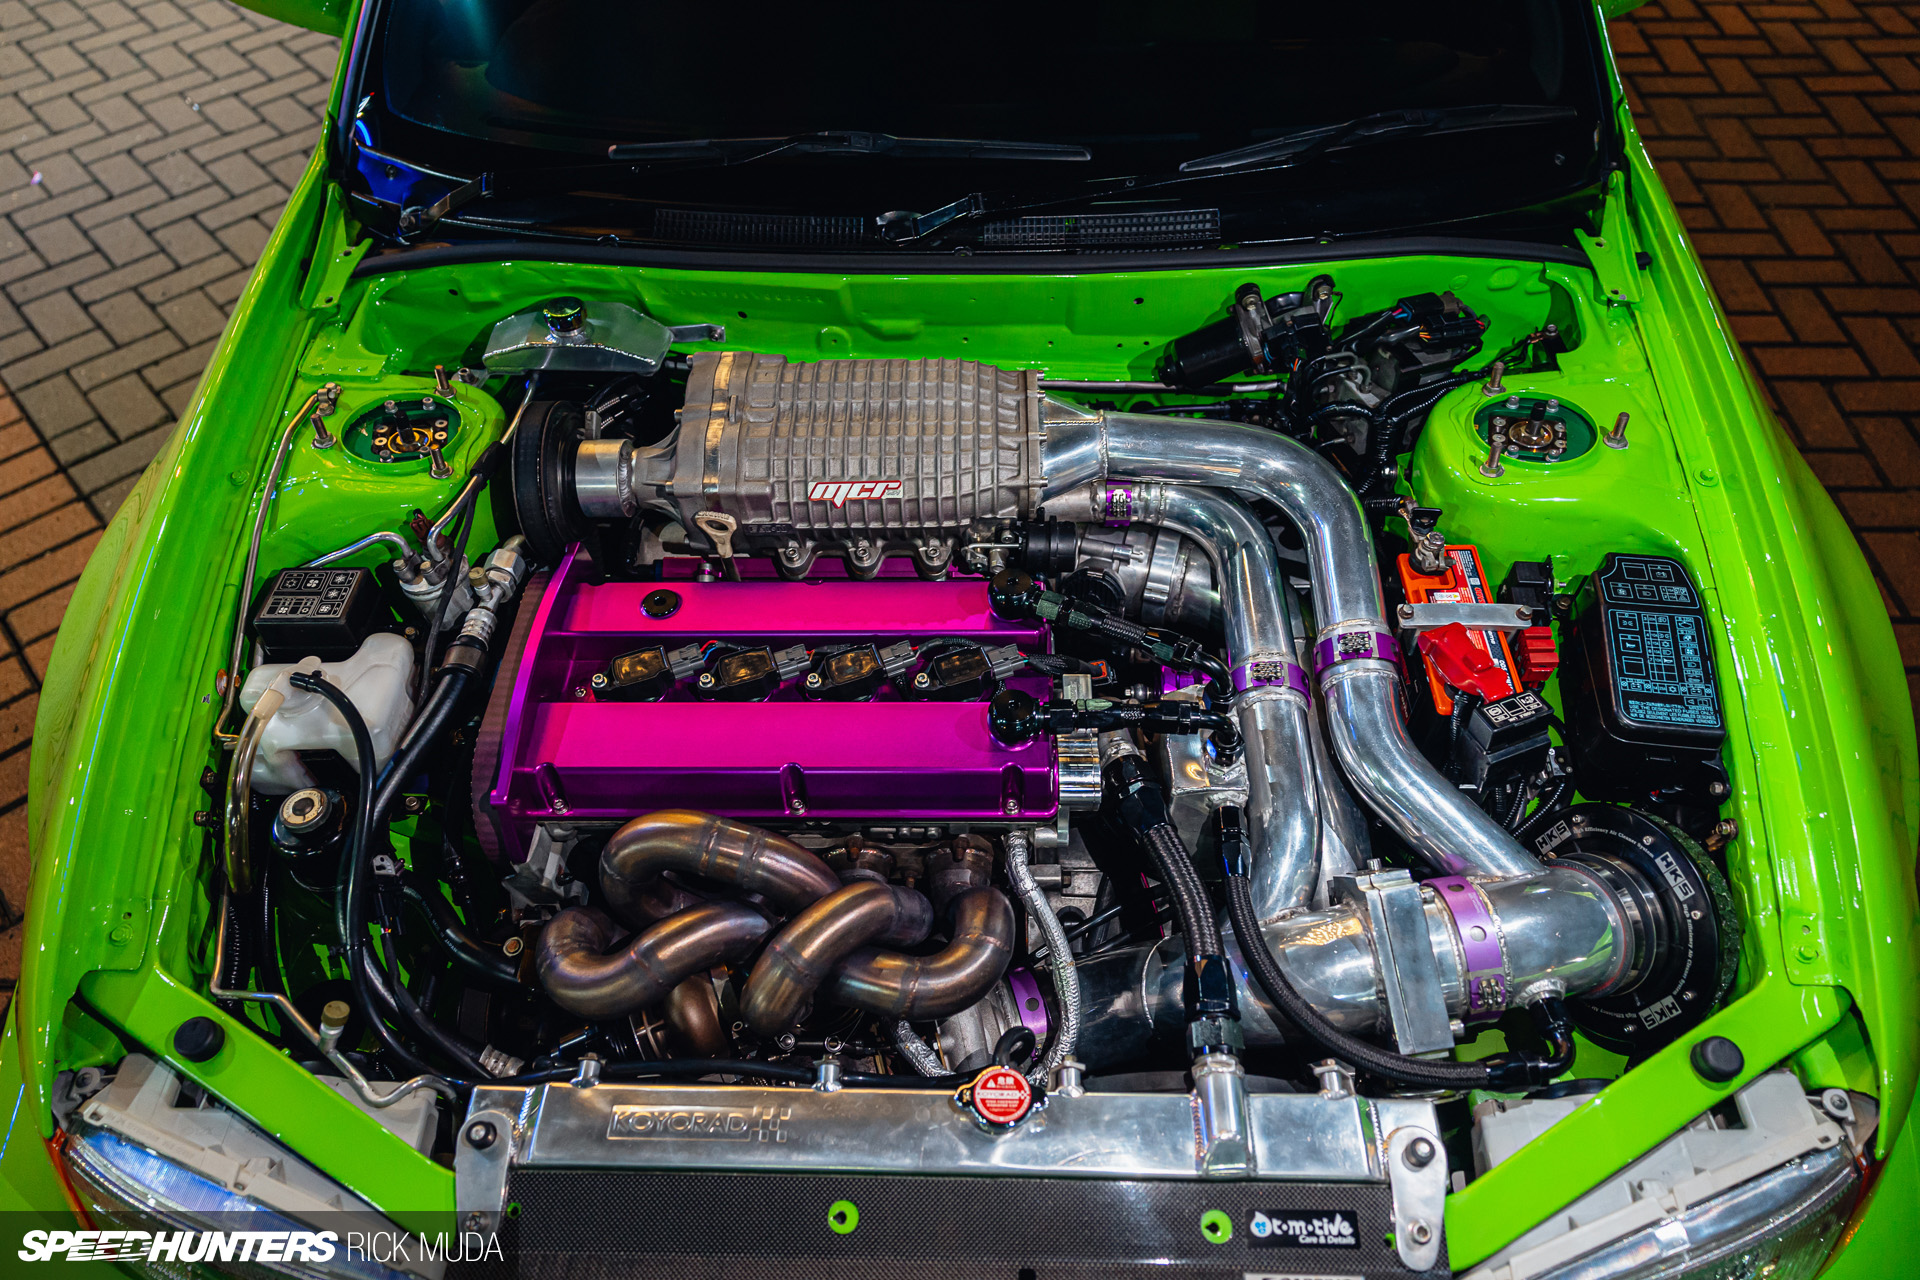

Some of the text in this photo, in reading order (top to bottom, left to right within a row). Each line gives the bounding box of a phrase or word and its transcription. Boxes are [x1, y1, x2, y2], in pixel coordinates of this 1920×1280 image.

[1536, 821, 1570, 852] HKS
[1585, 826, 1609, 834] Efficiency
[1618, 832, 1637, 846] Cleaner
[1637, 842, 1655, 858] System
[1657, 853, 1694, 899] HKS
[1686, 918, 1694, 948] Efficiency
[1684, 958, 1693, 981] Cleaner
[1641, 998, 1680, 1029] HKS
[612, 1110, 748, 1133] KOYORAD
[1298, 1235, 1356, 1245] Care & Details
